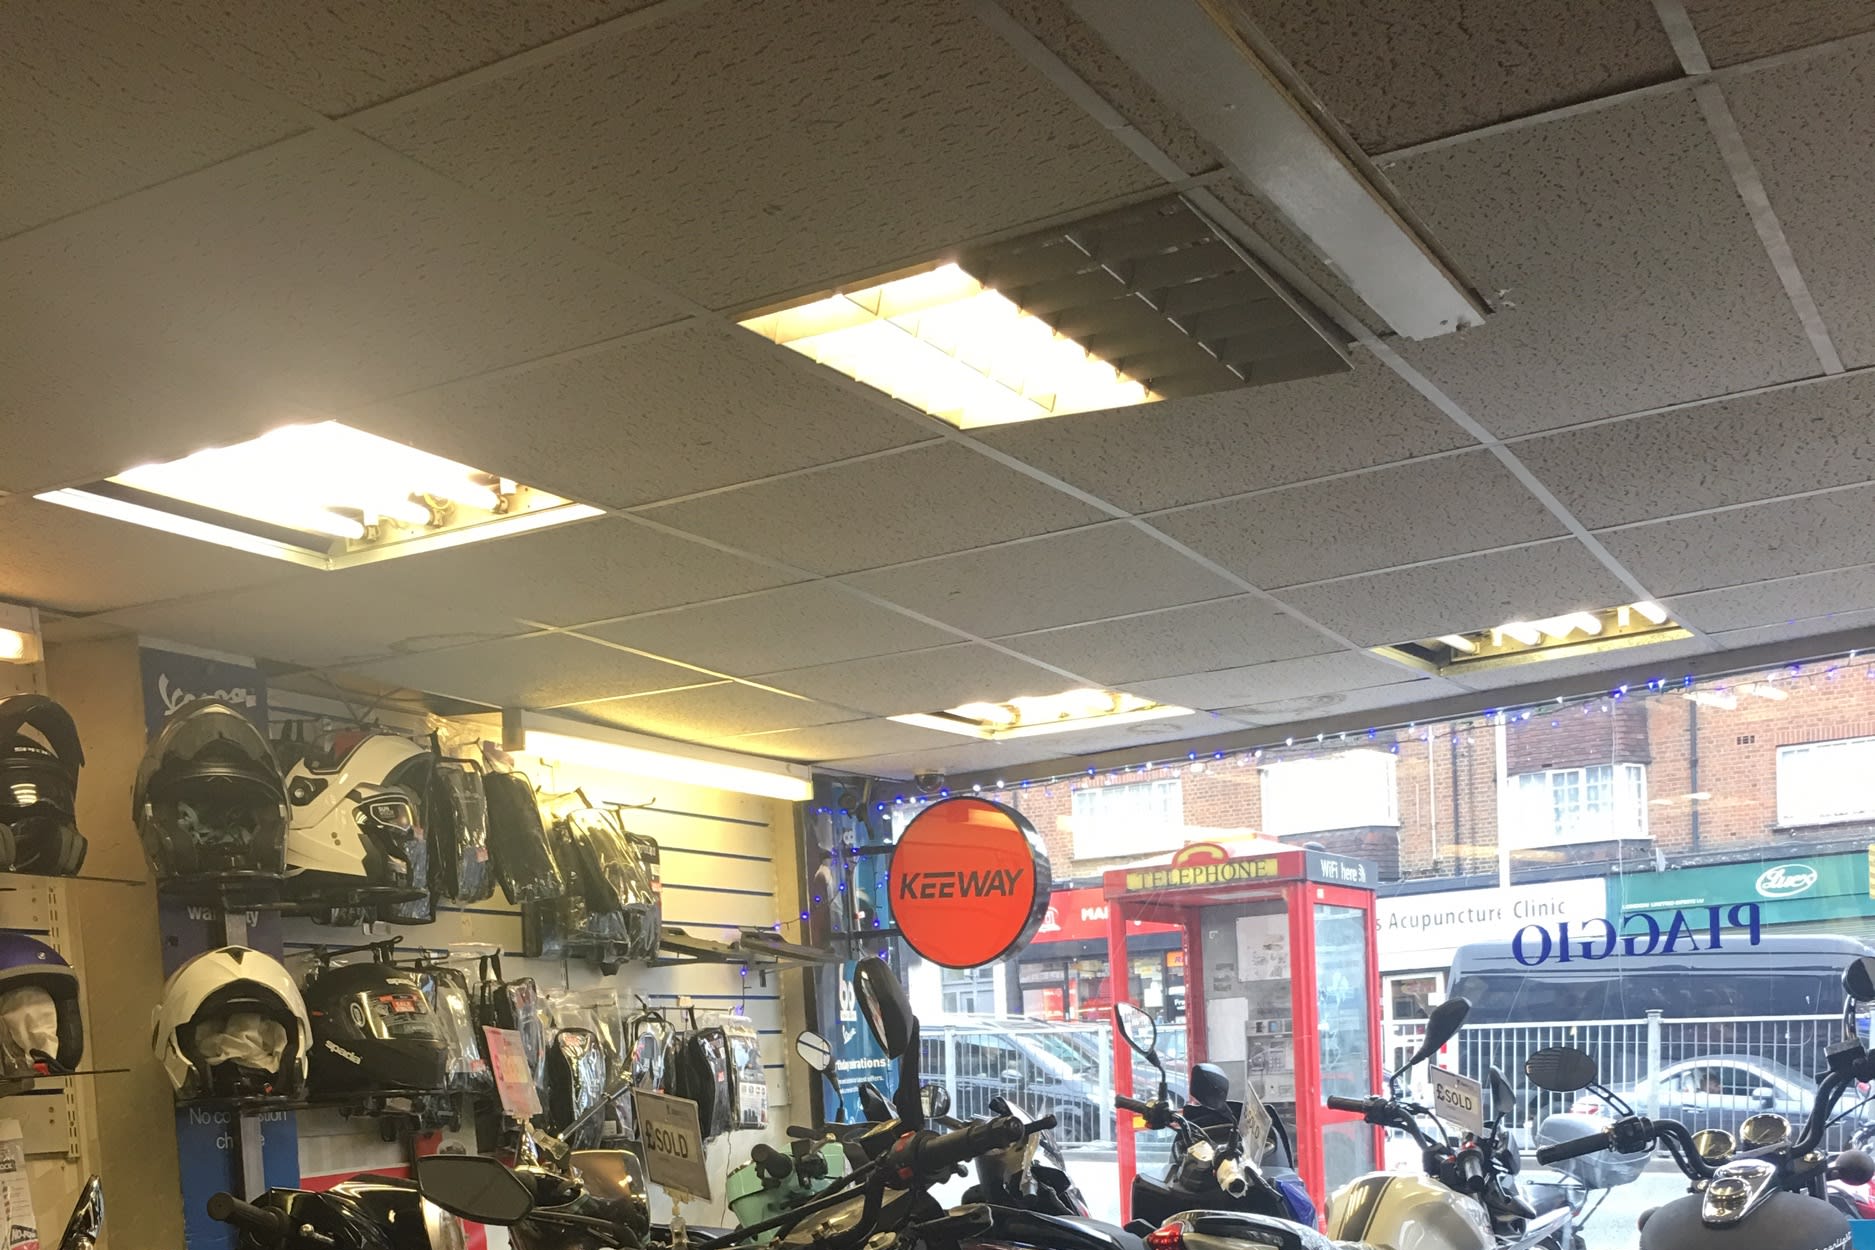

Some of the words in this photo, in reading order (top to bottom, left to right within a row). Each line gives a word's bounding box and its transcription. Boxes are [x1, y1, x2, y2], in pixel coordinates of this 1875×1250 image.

[899, 868, 1025, 900] KEEWAY
[1138, 860, 1268, 888] TELEPHONE
[1321, 859, 1339, 880] WiFi
[1340, 863, 1358, 882] here
[1388, 908, 1502, 932] Acupuncture
[1513, 897, 1566, 919] Clinic
[325, 1040, 362, 1065] spada
